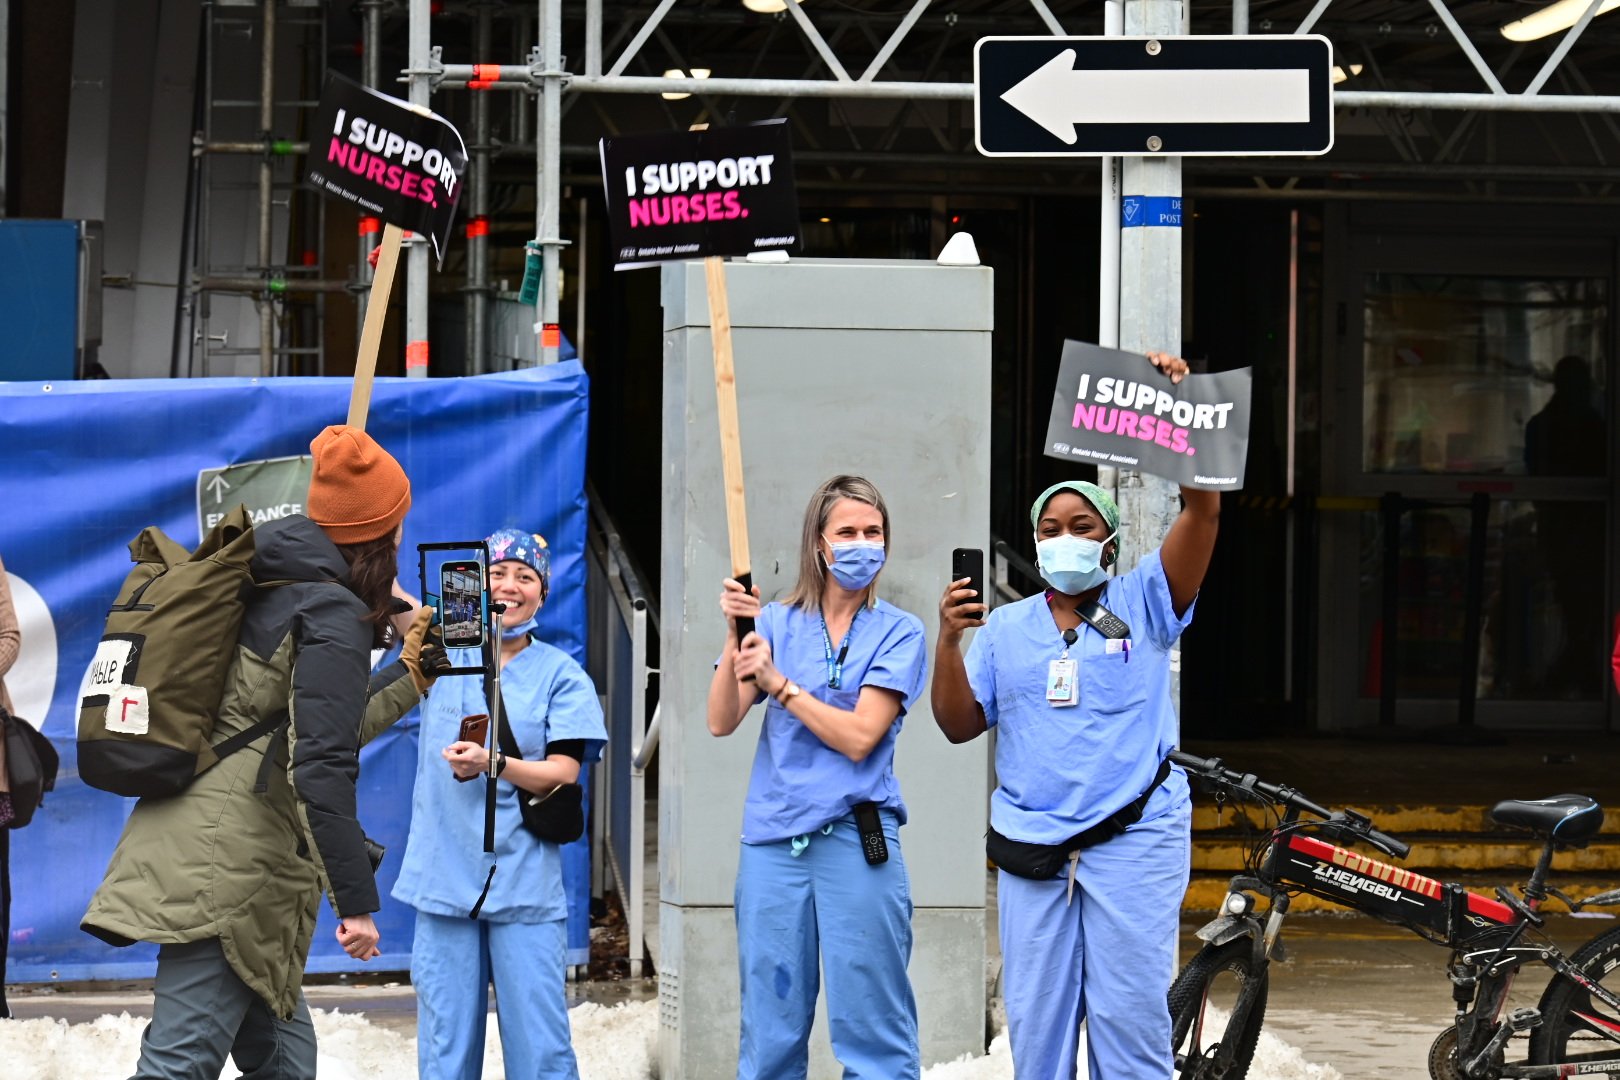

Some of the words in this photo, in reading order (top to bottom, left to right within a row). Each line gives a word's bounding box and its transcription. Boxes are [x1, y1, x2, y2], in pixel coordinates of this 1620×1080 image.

[327, 136, 438, 209] NURSES.
[333, 108, 346, 136] I
[348, 117, 457, 197] SUPPORT
[625, 166, 636, 197] I
[642, 154, 774, 196] SUPPORT
[629, 191, 749, 228] NURSES.
[1077, 373, 1090, 400] I
[1094, 376, 1234, 430] SUPPORT
[1072, 402, 1196, 457] NURSES.
[1312, 861, 1402, 902] ZHENGBU
[1580, 1063, 1620, 1073] ZHENG
